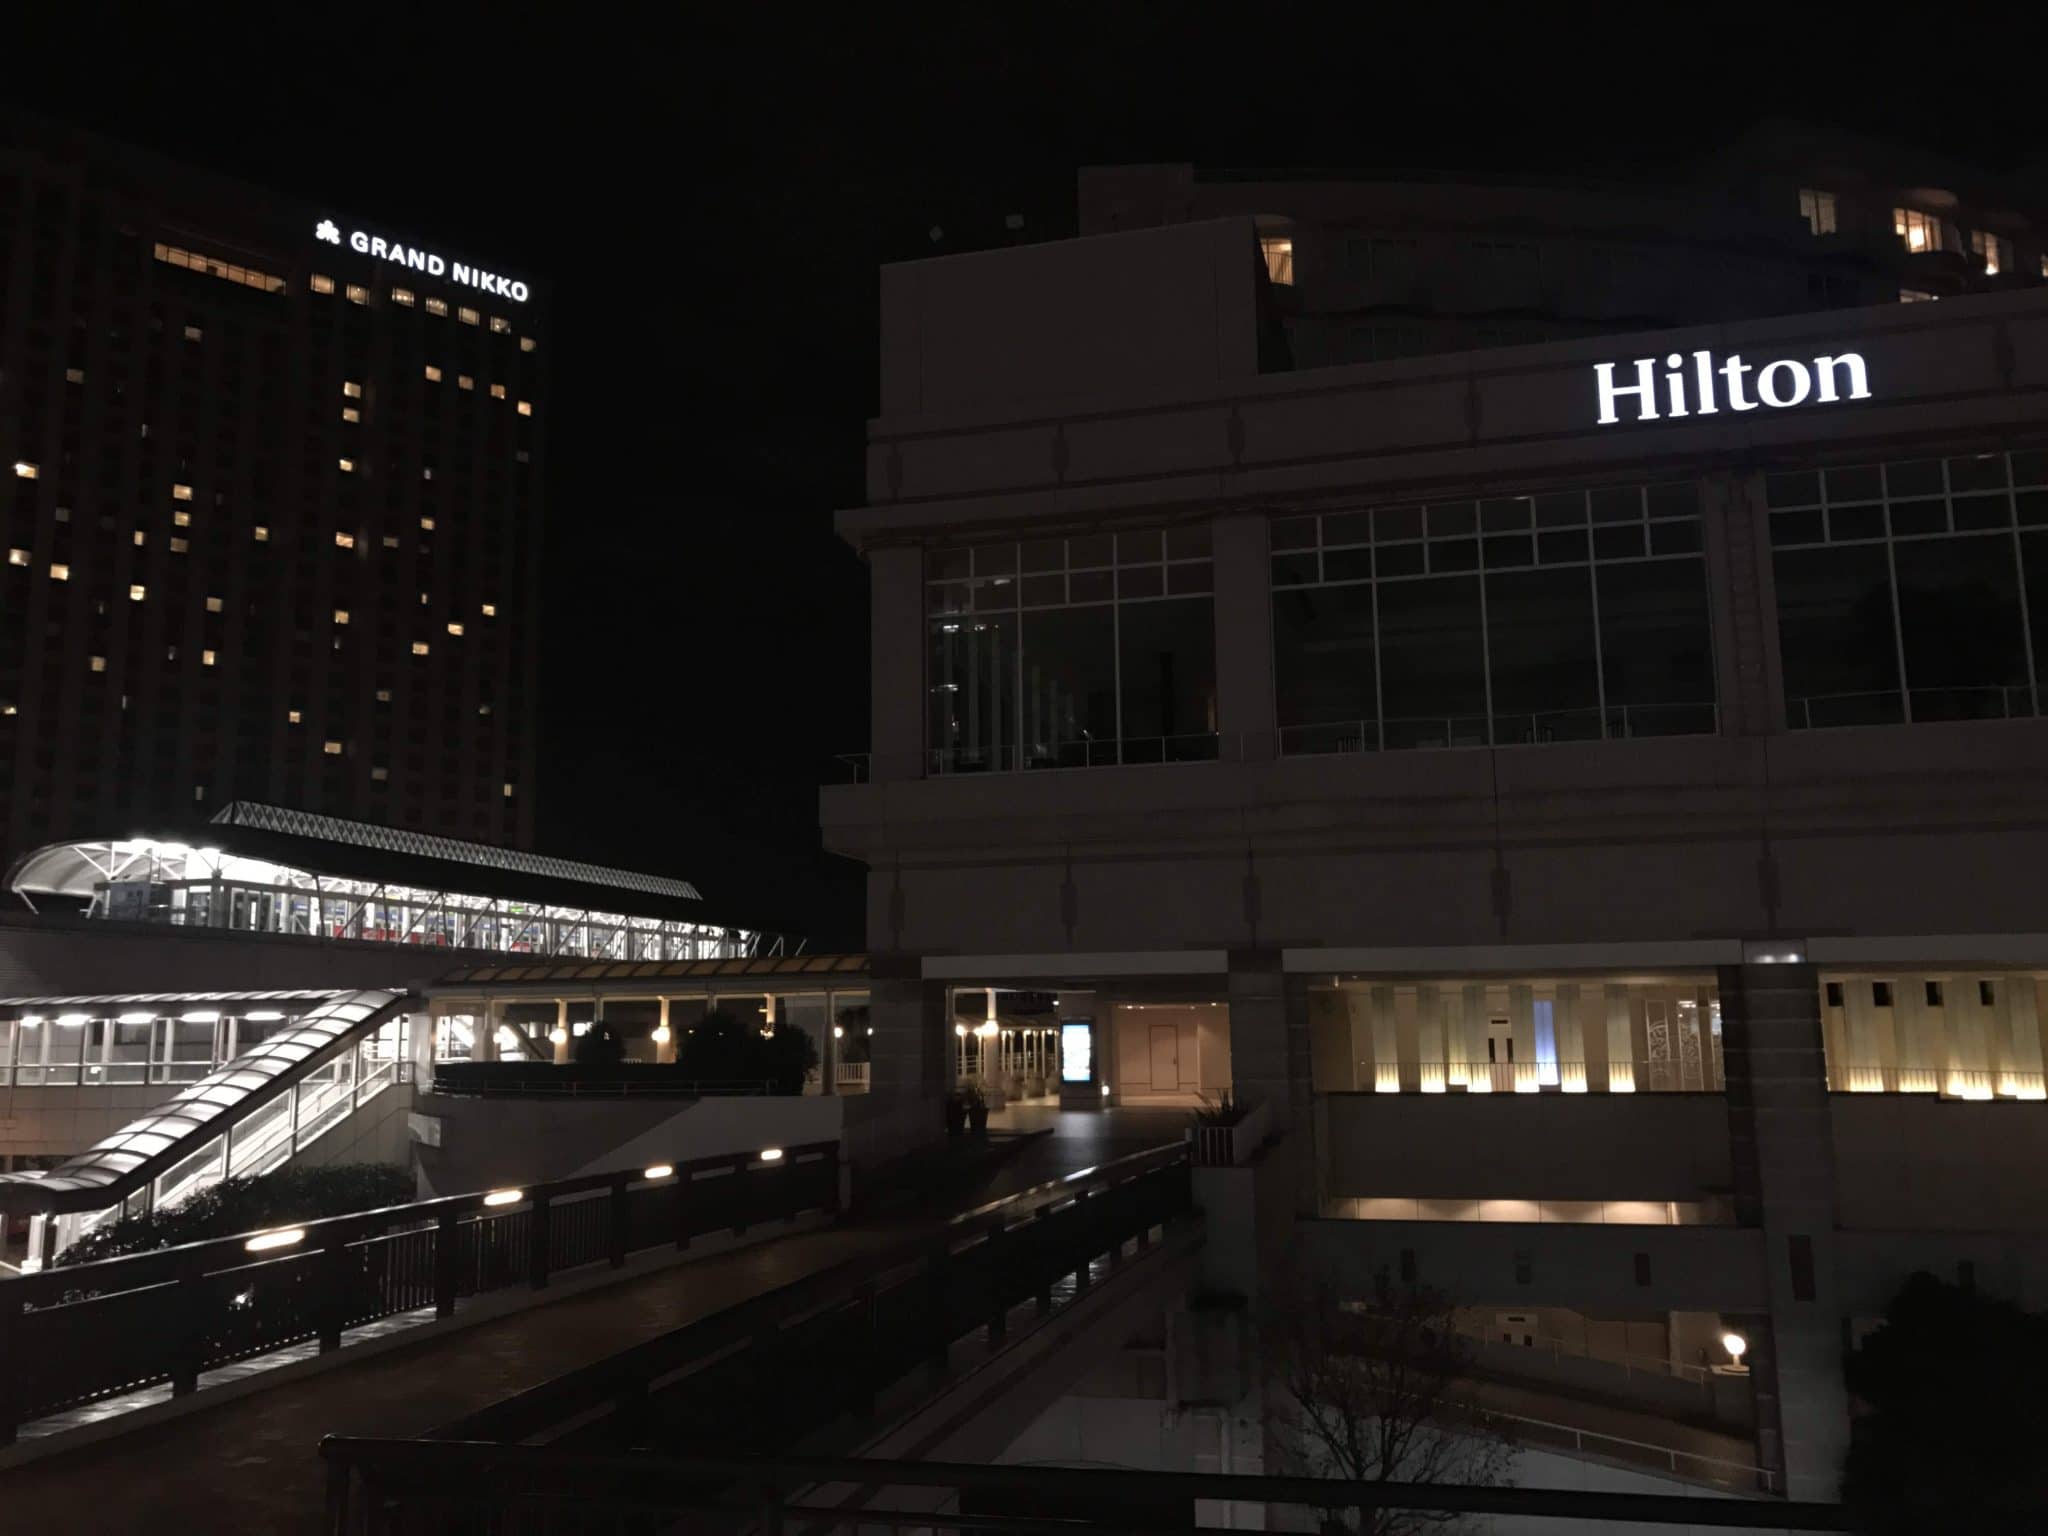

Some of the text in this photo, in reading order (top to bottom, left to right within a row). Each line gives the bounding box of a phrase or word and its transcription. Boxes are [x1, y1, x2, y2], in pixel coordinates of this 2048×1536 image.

[350, 231, 529, 302] GRAND NIKKO
[1593, 350, 1873, 425] Hilton
